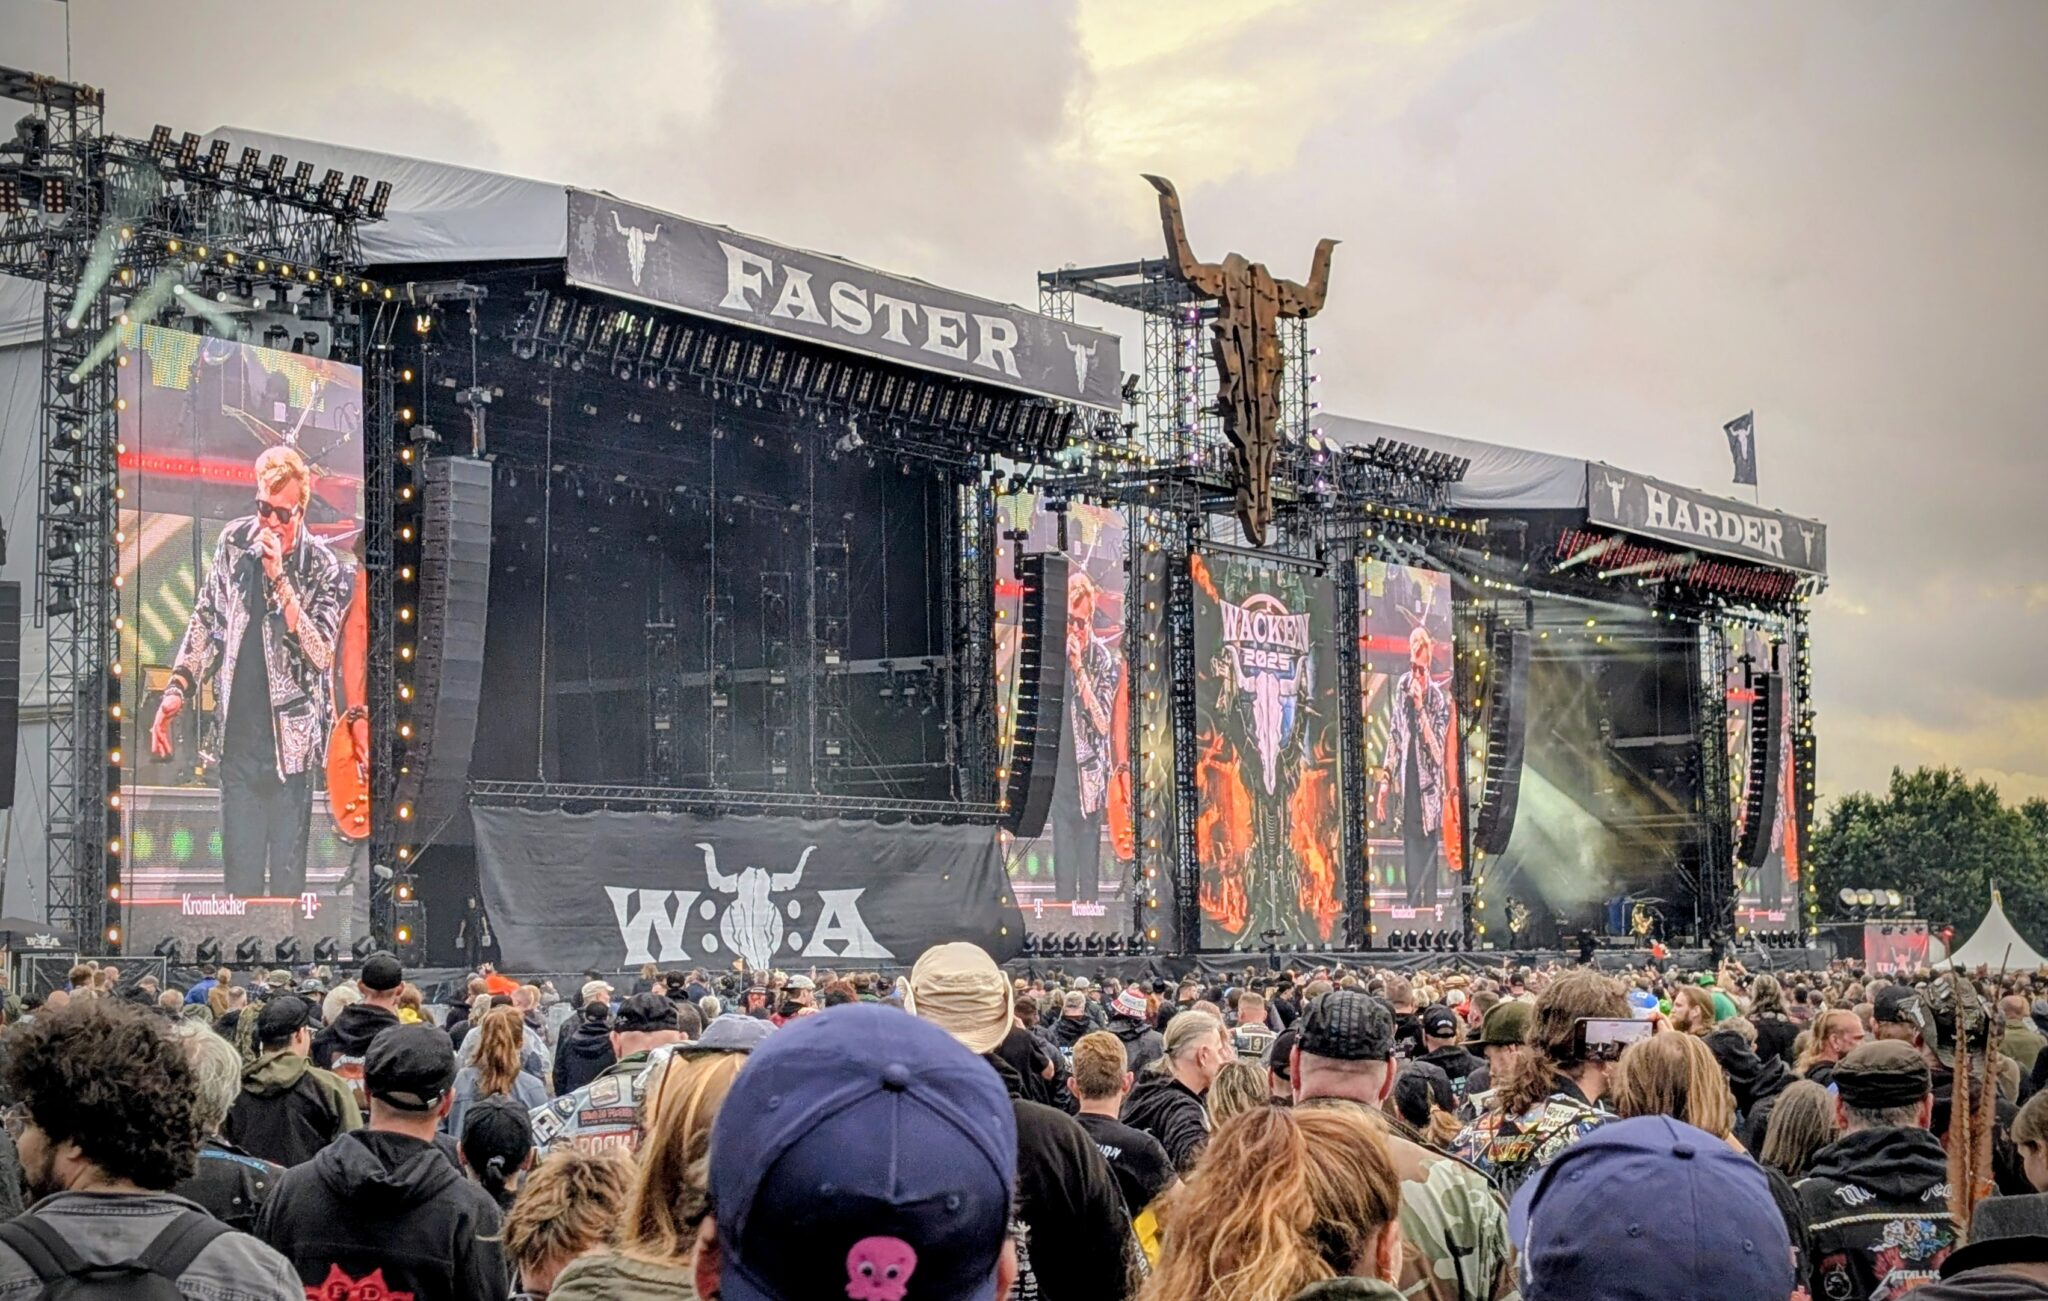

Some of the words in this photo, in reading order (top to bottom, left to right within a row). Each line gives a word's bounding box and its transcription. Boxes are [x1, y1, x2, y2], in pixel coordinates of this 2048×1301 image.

[717, 240, 1022, 379] FASTER
[1642, 483, 1786, 560] HARDER
[1219, 598, 1311, 653] WACKEN
[1240, 647, 1294, 671] 2025
[182, 892, 248, 916] Krombacher
